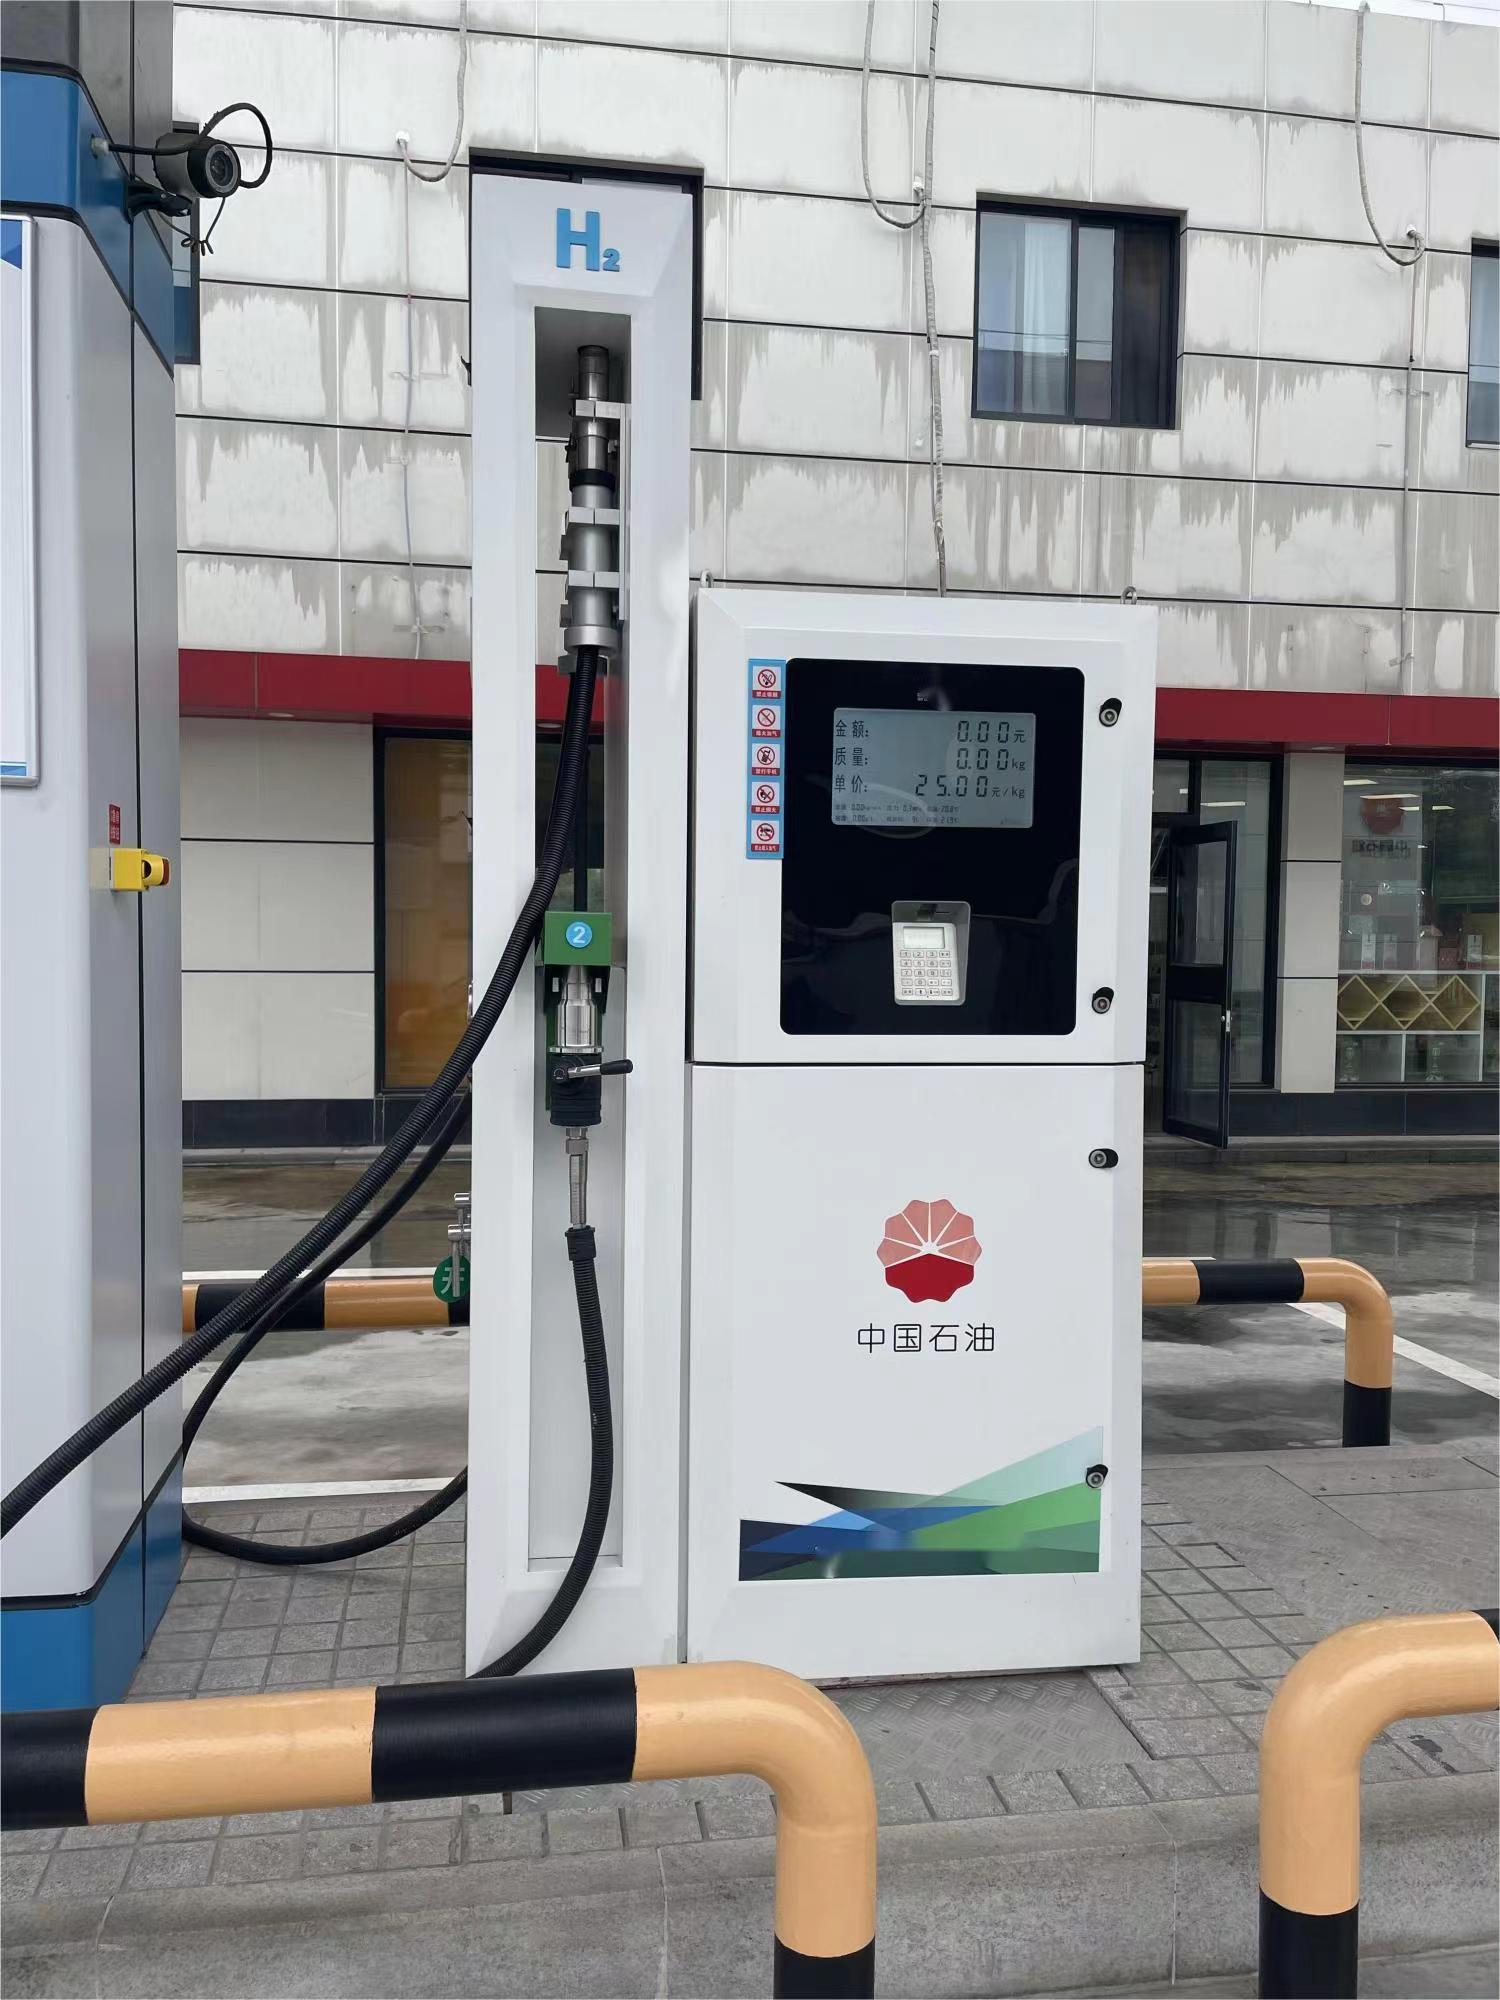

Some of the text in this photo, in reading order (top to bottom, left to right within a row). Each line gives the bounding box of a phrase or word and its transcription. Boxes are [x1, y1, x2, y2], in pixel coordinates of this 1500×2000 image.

[573, 926, 586, 944] 2
[858, 1323, 994, 1353] 中国石油
